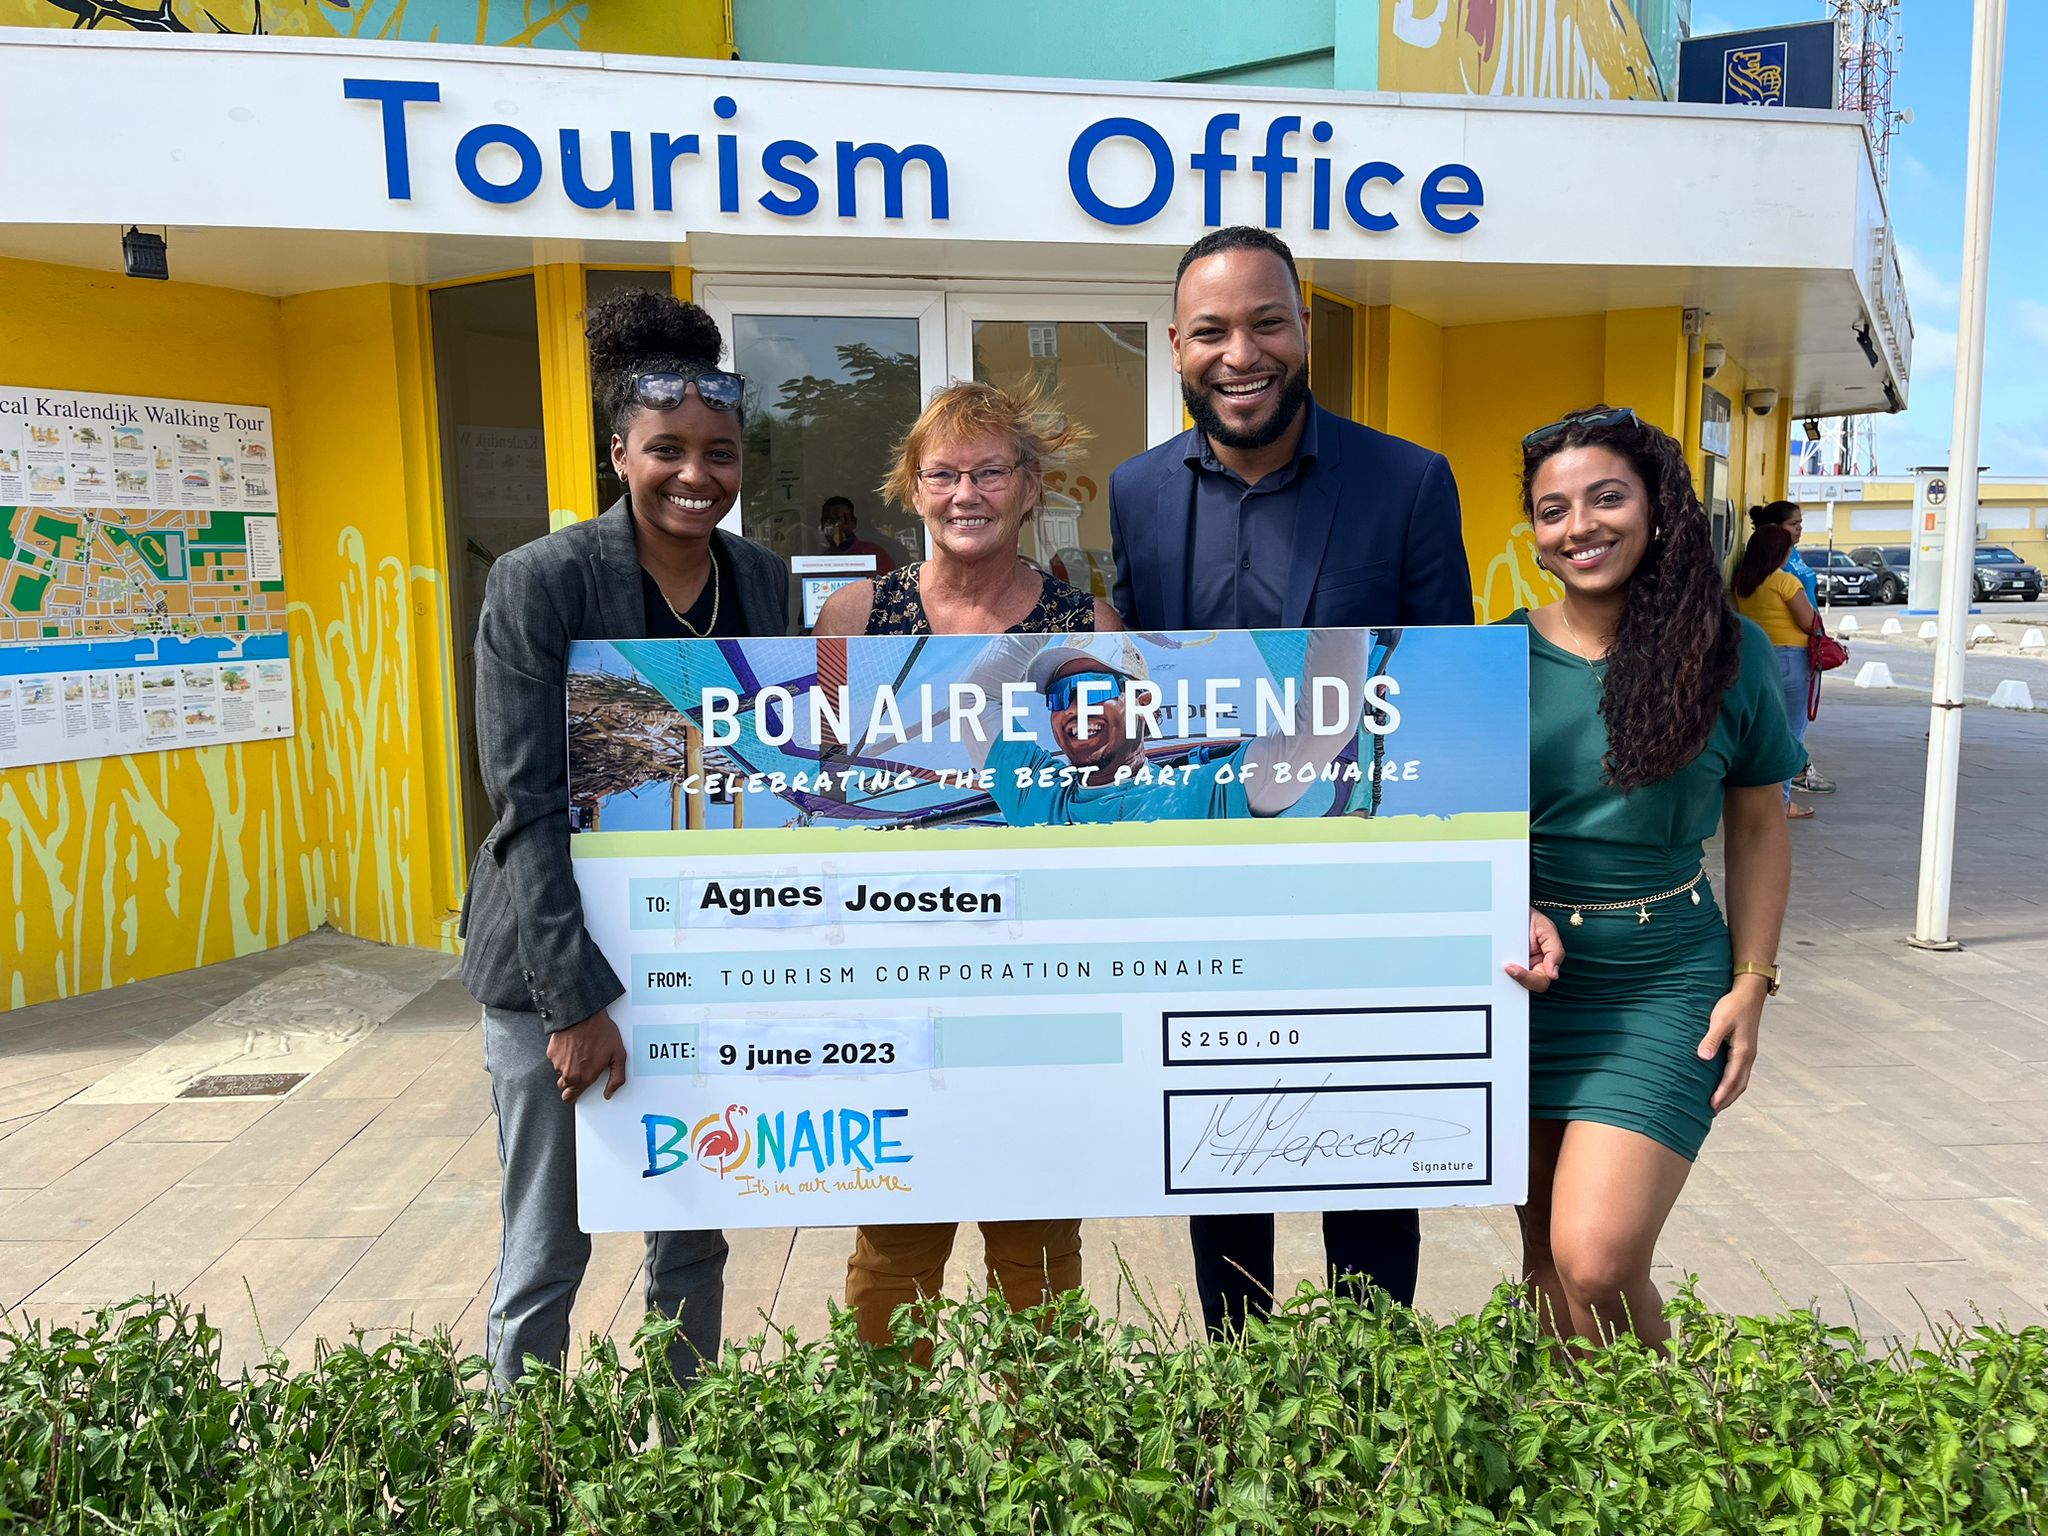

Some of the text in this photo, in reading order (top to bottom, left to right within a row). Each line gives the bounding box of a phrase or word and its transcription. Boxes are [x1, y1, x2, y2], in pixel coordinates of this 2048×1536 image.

[345, 80, 1486, 234] Tourism Office
[36, 397, 139, 426] Kralendijk
[144, 406, 220, 432] Walking
[224, 413, 265, 432] Tour
[702, 675, 1401, 747] BONAIRE FRIENDS
[683, 760, 1420, 795] CELEBRATING THE BEST PART OF BONAIRE
[646, 883, 1002, 915] TO: Agnes Joosten
[648, 958, 1245, 988] FROM: TOURISM CORPORATION BONAIRE
[1181, 1030, 1300, 1048] $250,00
[649, 1043, 896, 1071] DATE: 9 june 2023
[640, 1104, 914, 1179] BONAIRE
[1412, 1160, 1474, 1174] Signature
[775, 1179, 796, 1195] in
[799, 1177, 830, 1194] our
